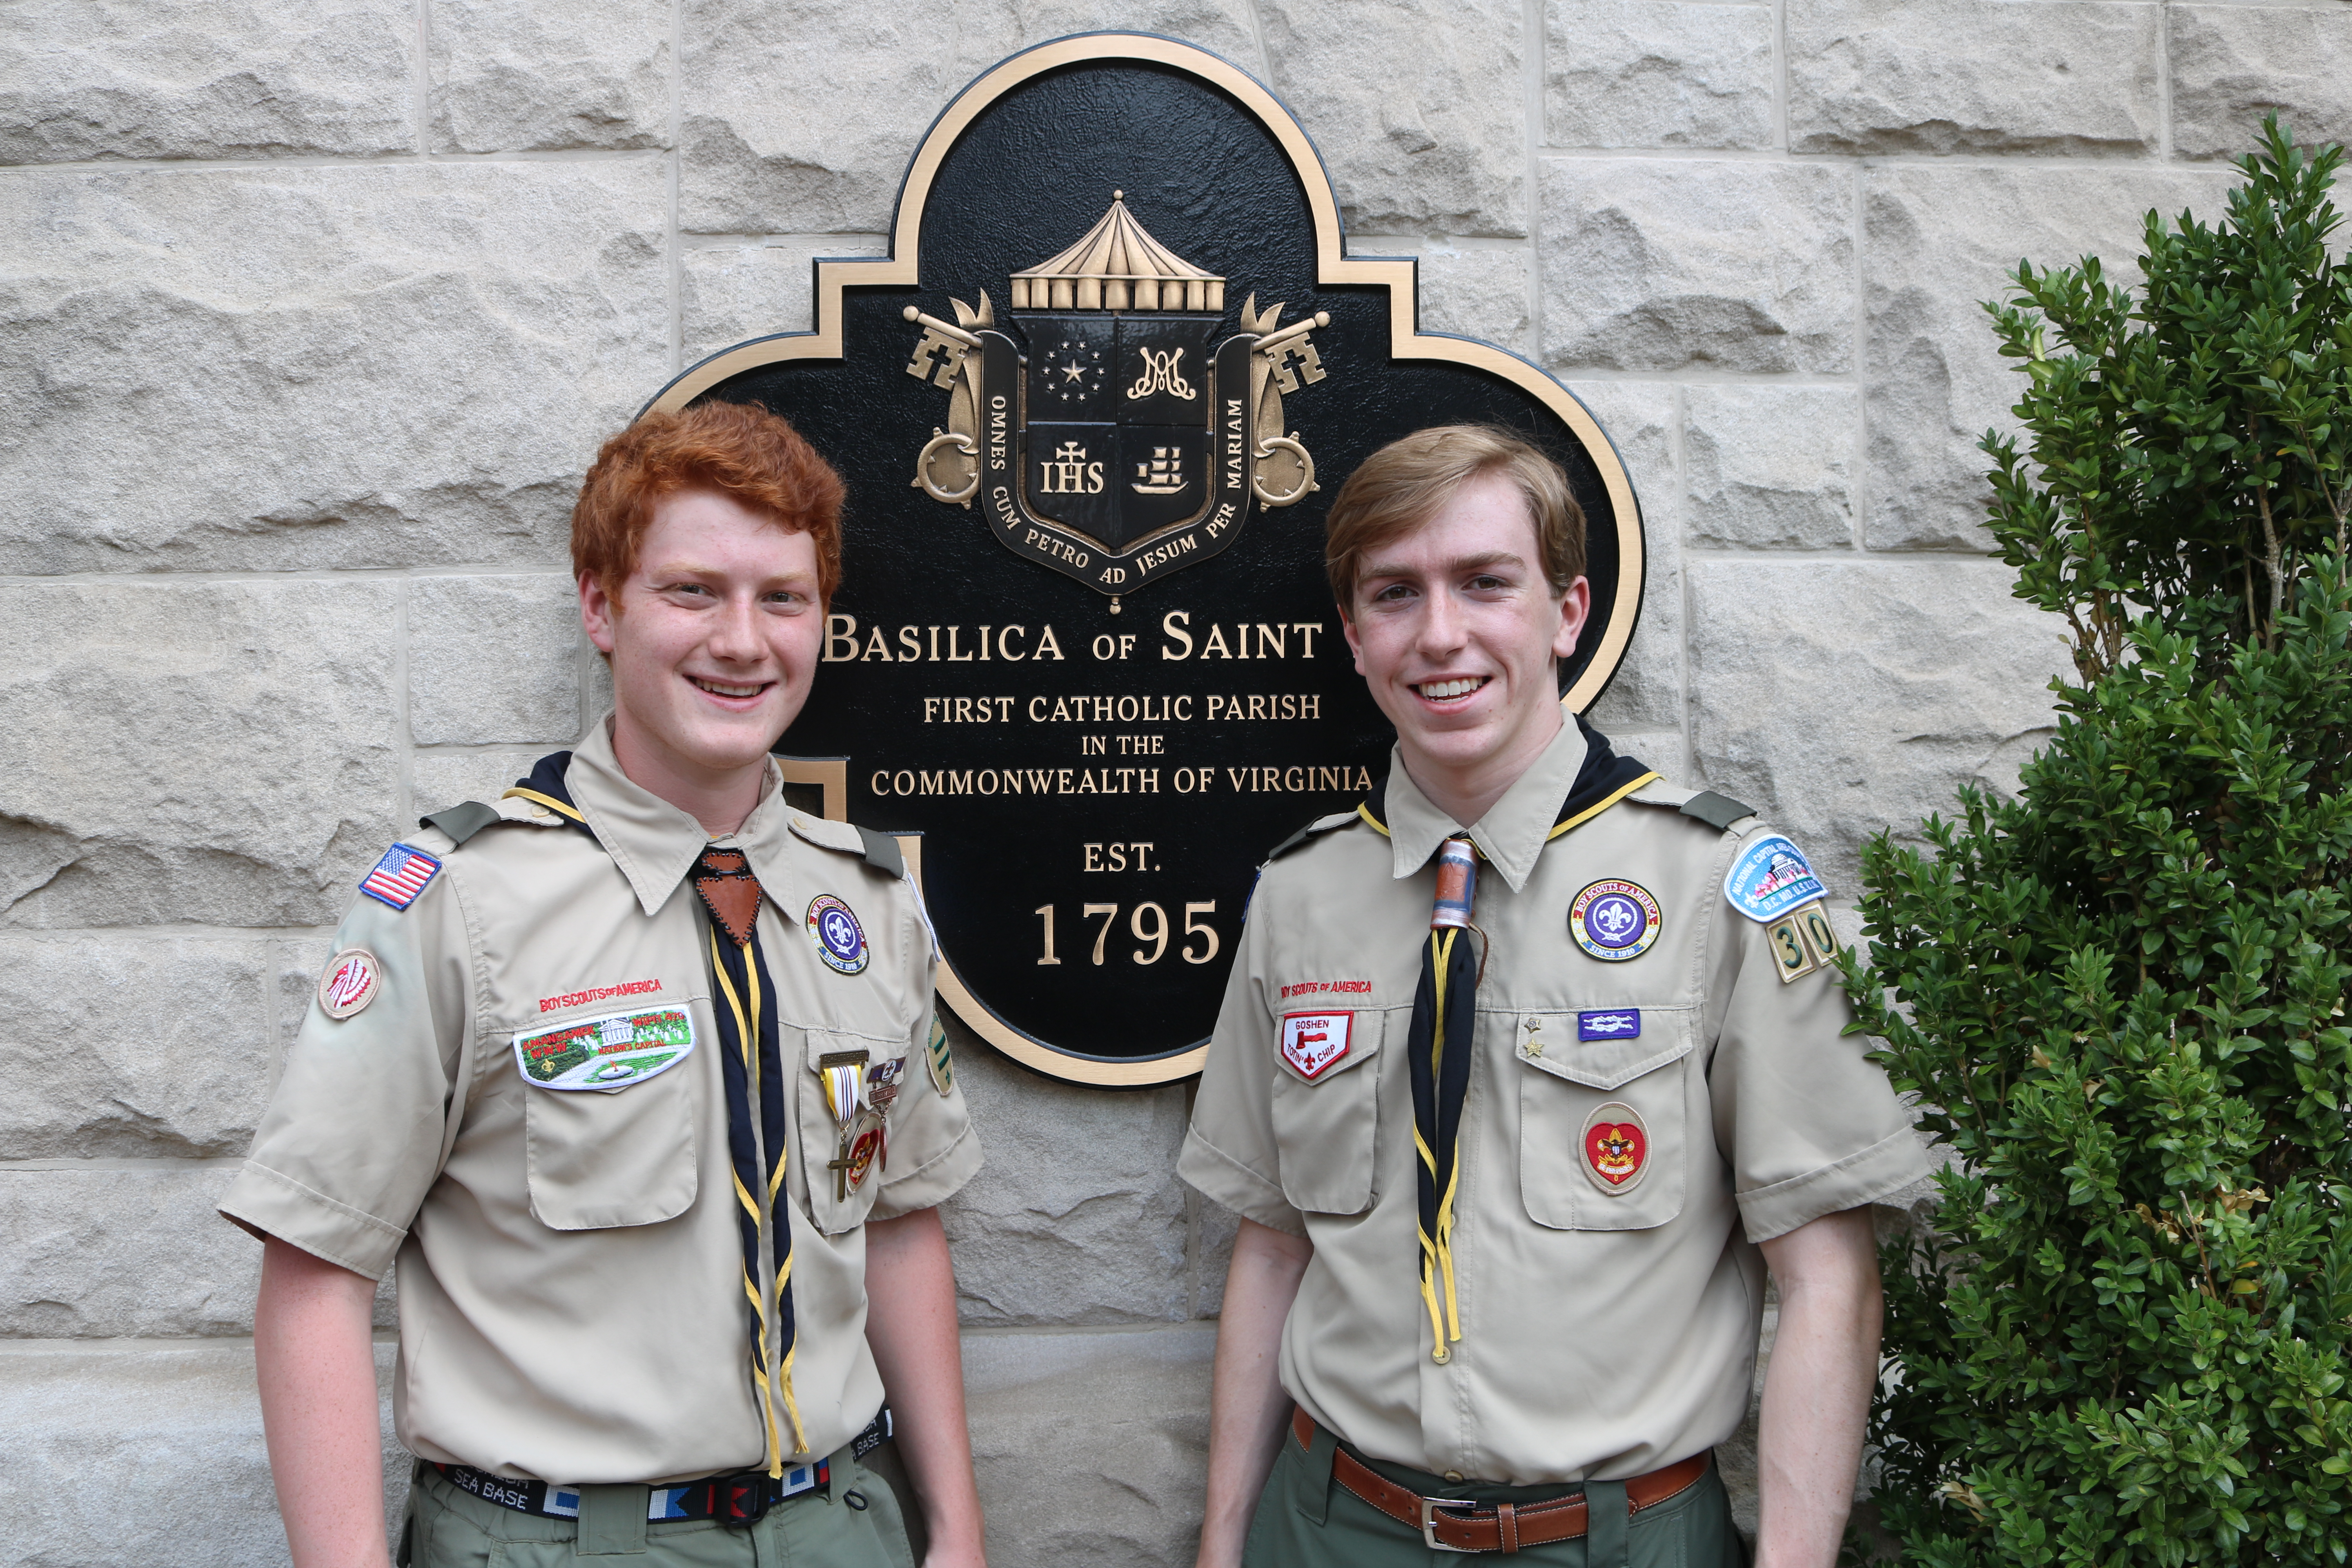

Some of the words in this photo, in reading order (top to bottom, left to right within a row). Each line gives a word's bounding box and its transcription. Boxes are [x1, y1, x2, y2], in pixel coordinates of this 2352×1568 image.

[991, 396, 1006, 470] OMNES
[1227, 399, 1242, 489] MARIAM
[1040, 459, 1103, 494] IHS
[993, 486, 1021, 530] CUM
[1205, 503, 1236, 539] PER
[1024, 528, 1089, 568] PETRO
[1135, 534, 1197, 576] JESUM
[1099, 567, 1125, 584] AD
[822, 614, 1065, 662] BASILICA
[1093, 635, 1136, 660] OF
[1162, 611, 1323, 661] SAINT
[924, 697, 1014, 723] FIRST
[1029, 696, 1192, 722] CATHOLIC
[1207, 695, 1320, 720] PARISH
[1082, 736, 1106, 755] IN
[1116, 735, 1164, 754] THE
[871, 768, 1159, 795] COMMONWEALTH
[1174, 767, 1215, 793] OF
[1227, 766, 1372, 792] VIRGINIA
[1083, 843, 1161, 872] EST.
[1732, 861, 1757, 896] NATIONAL
[1753, 844, 1779, 864] CAPITAL
[810, 904, 820, 918] BOY
[817, 898, 838, 909] SCOUTS
[1575, 895, 1589, 913] BOY
[1586, 883, 1618, 899] SCOUTS
[1628, 887, 1657, 919] AMERICA
[1762, 897, 1782, 911] D.C.
[1035, 900, 1219, 965] 1795
[1777, 913, 1833, 969] 30
[824, 952, 844, 969] SINCE
[1589, 945, 1615, 958] SINCE
[1617, 947, 1635, 957] 1910
[539, 996, 561, 1012] BOY
[563, 987, 606, 1007] SCOUTS
[616, 978, 662, 996] AMERICA
[1281, 986, 1290, 998] BOY
[1291, 982, 1318, 996] SCOUTS
[1320, 983, 1330, 991] OF
[1330, 981, 1372, 993] AMERICA
[665, 1012, 685, 1021] 470
[1296, 1020, 1329, 1030] GOSHEN
[523, 1025, 595, 1051] AMANGAMEK
[635, 1040, 666, 1049] CAPITAL
[1287, 1043, 1304, 1063] TOTIN'
[1318, 1044, 1335, 1062] CHIP
[857, 1432, 879, 1456] BASE
[454, 1468, 478, 1493] SEA
[483, 1482, 528, 1510] BASE
